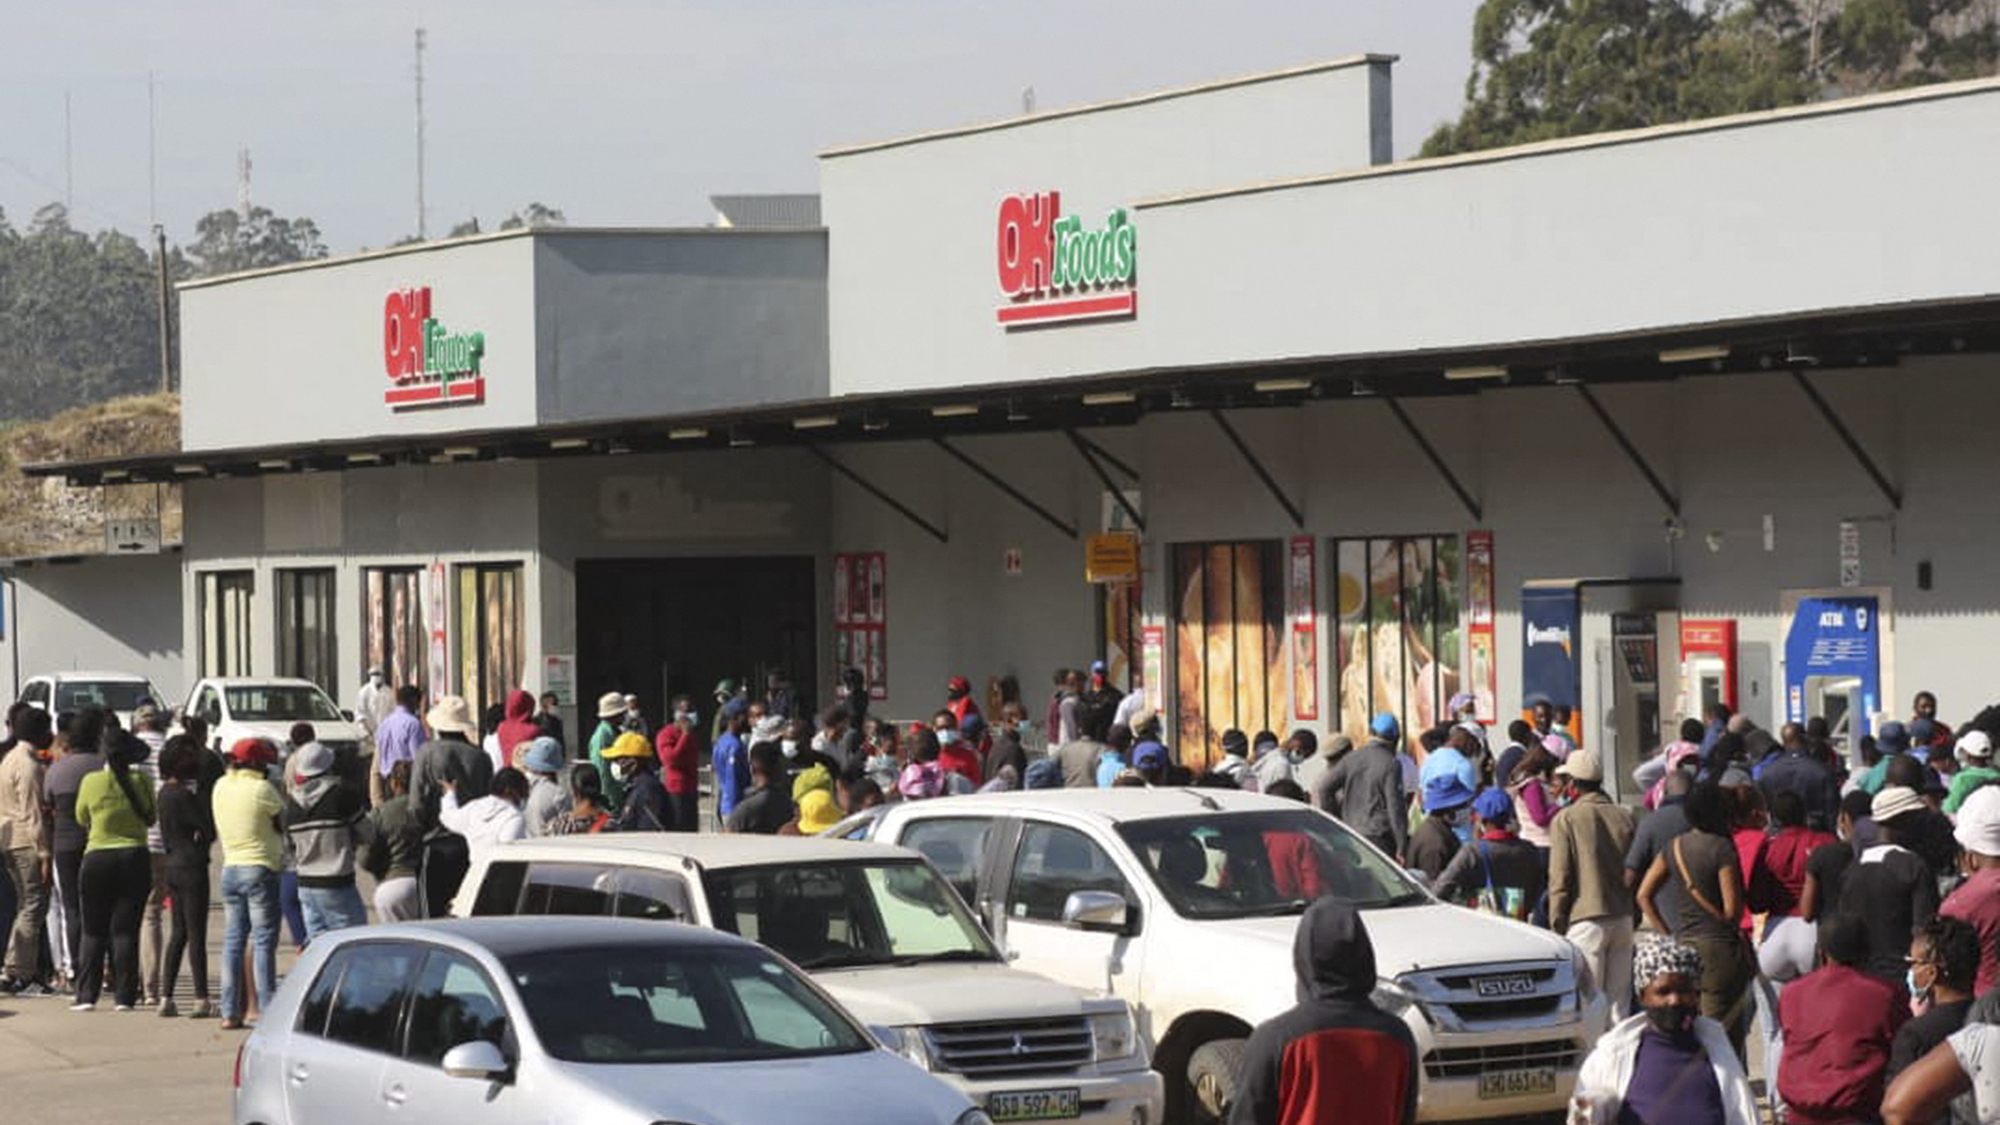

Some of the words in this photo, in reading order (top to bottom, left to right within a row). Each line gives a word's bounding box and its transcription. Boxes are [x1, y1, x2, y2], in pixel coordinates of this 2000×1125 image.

[998, 190, 1059, 298] OK
[1053, 209, 1136, 289] Foods
[384, 287, 431, 379] OK
[1479, 979, 1535, 995] ISUZU
[1023, 1094, 1051, 1115] 597
